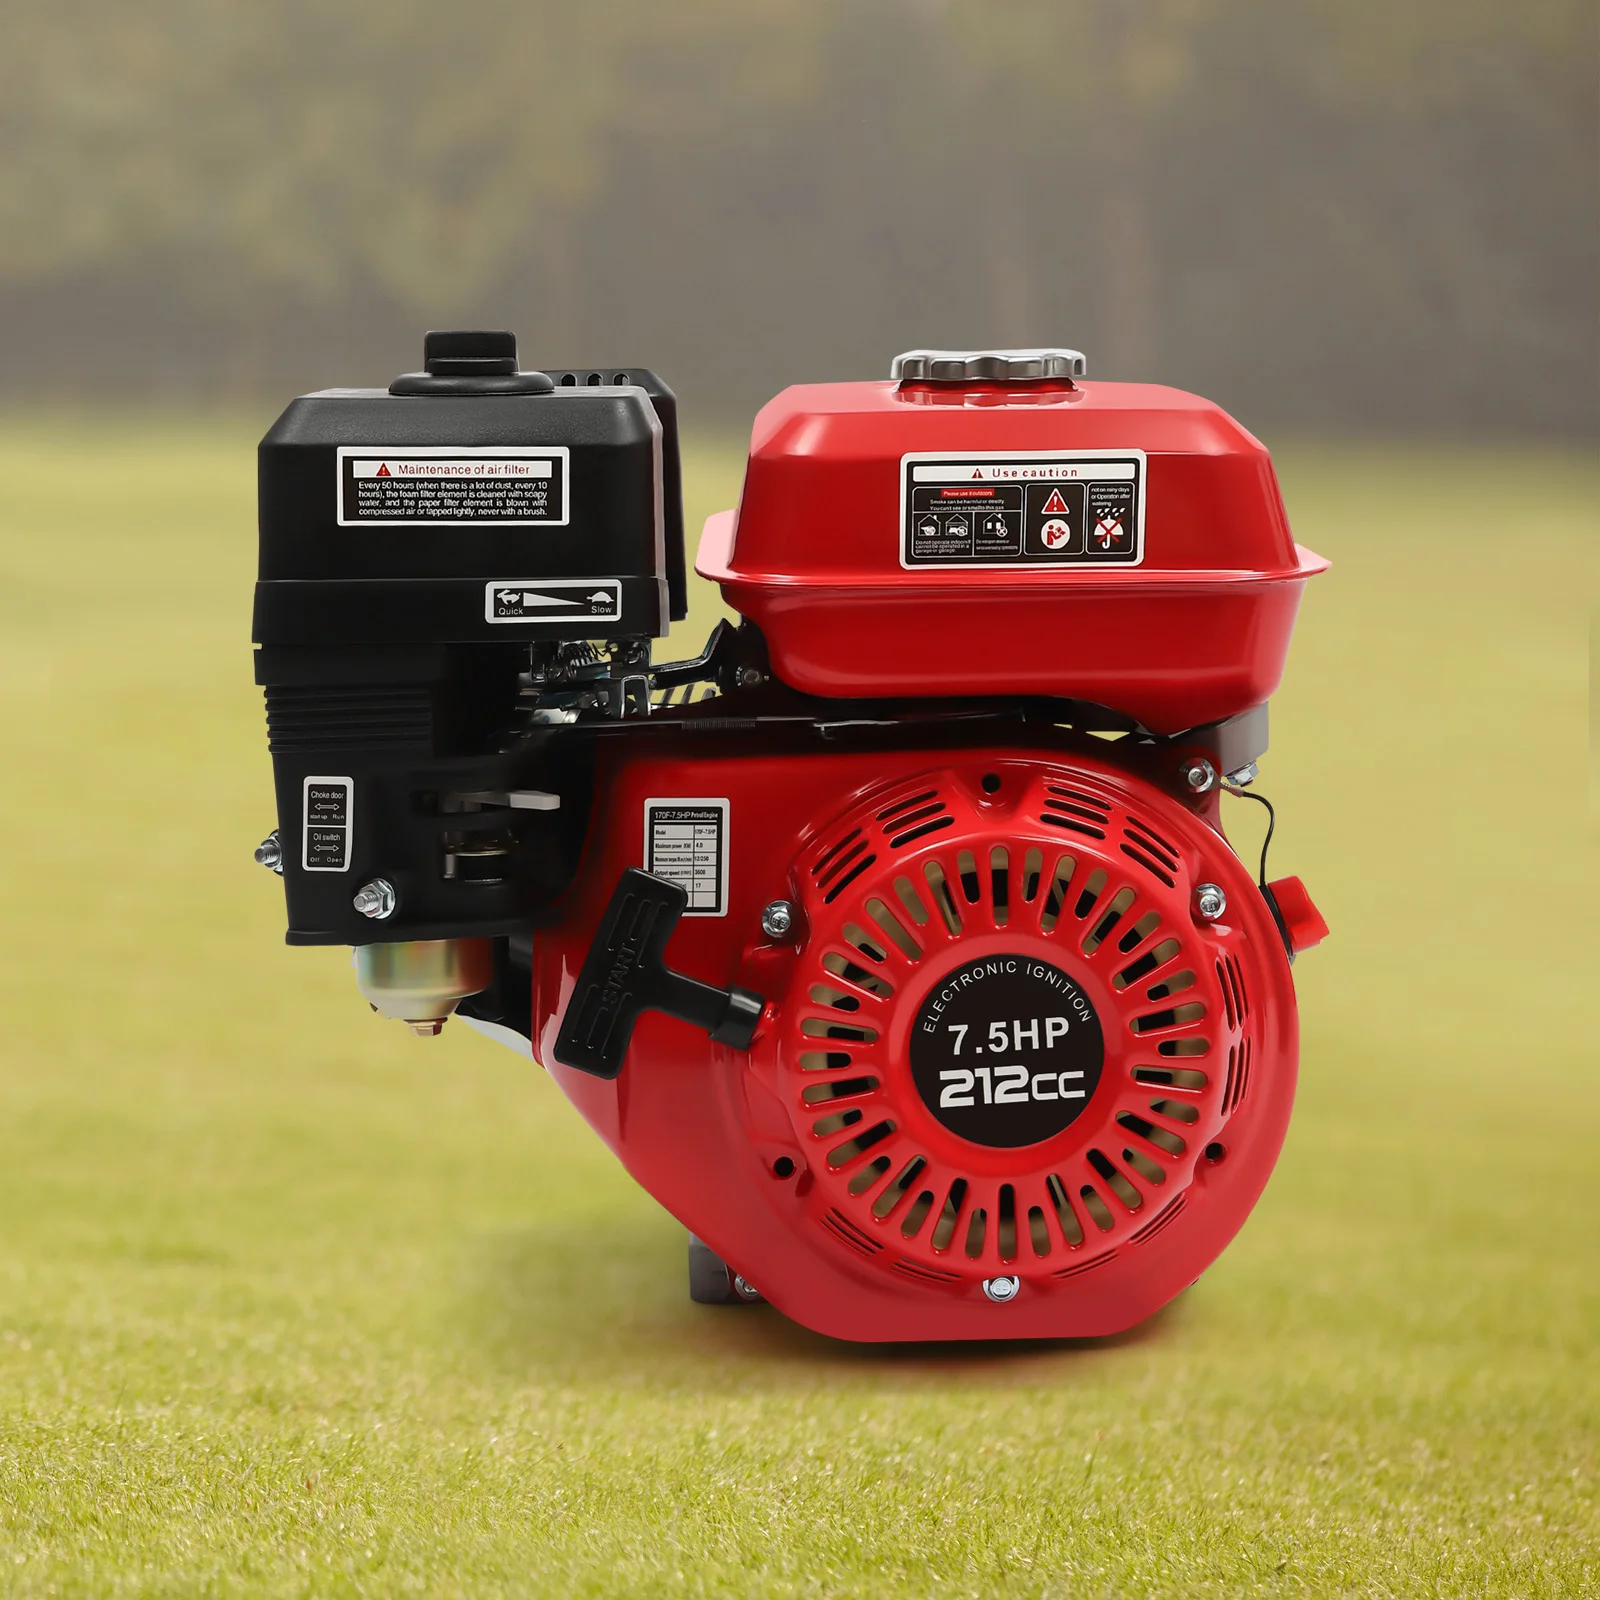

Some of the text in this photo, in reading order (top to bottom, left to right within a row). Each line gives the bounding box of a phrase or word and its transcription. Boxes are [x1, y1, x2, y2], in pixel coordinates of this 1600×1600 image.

[398, 464, 530, 475] Maintenance of air filter
[992, 467, 1078, 478] Use caution
[358, 481, 380, 490] Every
[382, 481, 391, 489] 50
[393, 481, 415, 489] hours
[416, 481, 439, 490] (when
[440, 481, 460, 489] there
[461, 481, 468, 489] is
[476, 481, 485, 489] lot
[486, 481, 494, 489] of
[495, 481, 514, 490] dust,
[515, 482, 537, 491] every
[538, 481, 548, 489] 10
[358, 490, 385, 500] hours),
[438, 490, 467, 498] element
[469, 490, 475, 498] is
[477, 490, 506, 498] cleaned
[508, 490, 523, 498] with
[524, 491, 547, 500] soapy
[358, 499, 382, 507] water,
[358, 508, 405, 516] compressed
[426, 508, 452, 516] tapped
[453, 508, 476, 516] lightly,
[498, 605, 612, 615] Quick Slow
[331, 791, 344, 799] door
[923, 960, 1093, 1033] ELECTRONIC IGNITION
[948, 1016, 1069, 1055] 7.5HP
[939, 1065, 1086, 1108] 212cc
